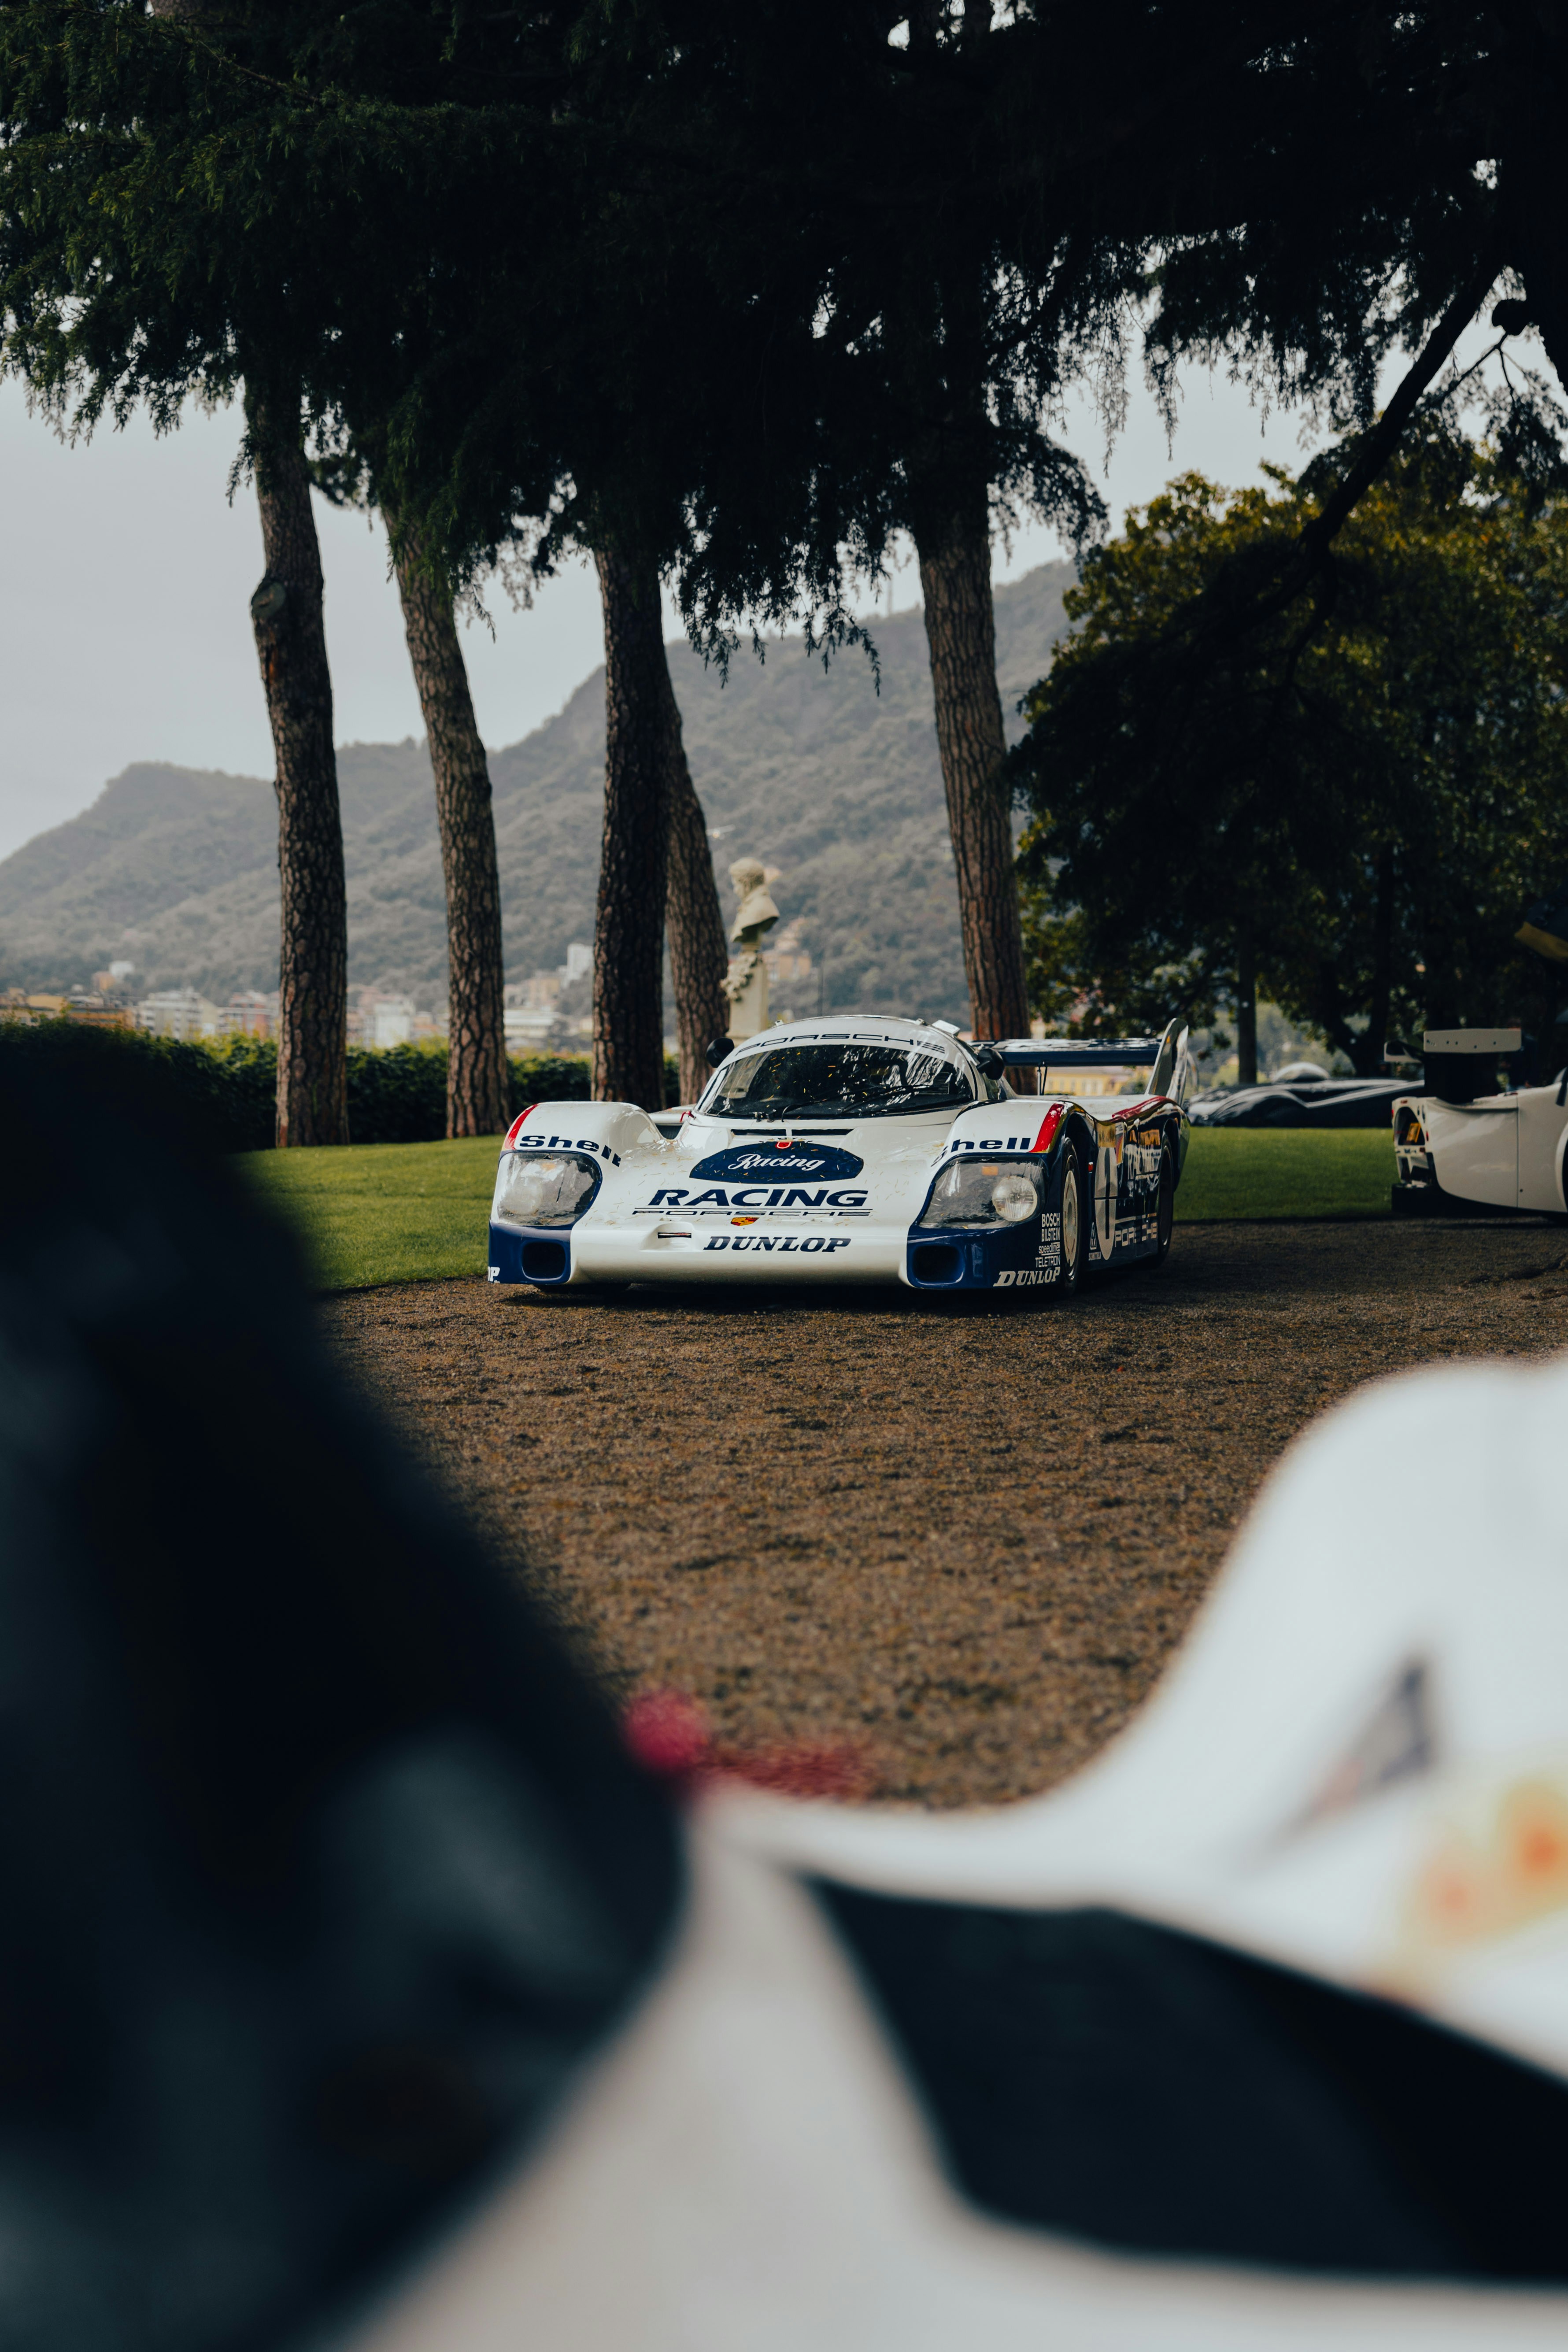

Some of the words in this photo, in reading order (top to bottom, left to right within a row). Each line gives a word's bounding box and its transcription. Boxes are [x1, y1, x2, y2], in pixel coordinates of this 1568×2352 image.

[735, 1034, 945, 1056] PORSCHE
[520, 1135, 621, 1167] Shell
[728, 1154, 825, 1171] Racing
[647, 1189, 869, 1207] RACING
[1042, 1213, 1060, 1228] BOSCH
[1041, 1228, 1060, 1242] BILSTEIN
[703, 1236, 851, 1253] DUNLOP
[1035, 1255, 1061, 1268] TELETRON
[993, 1267, 1061, 1287] DUNLOP
